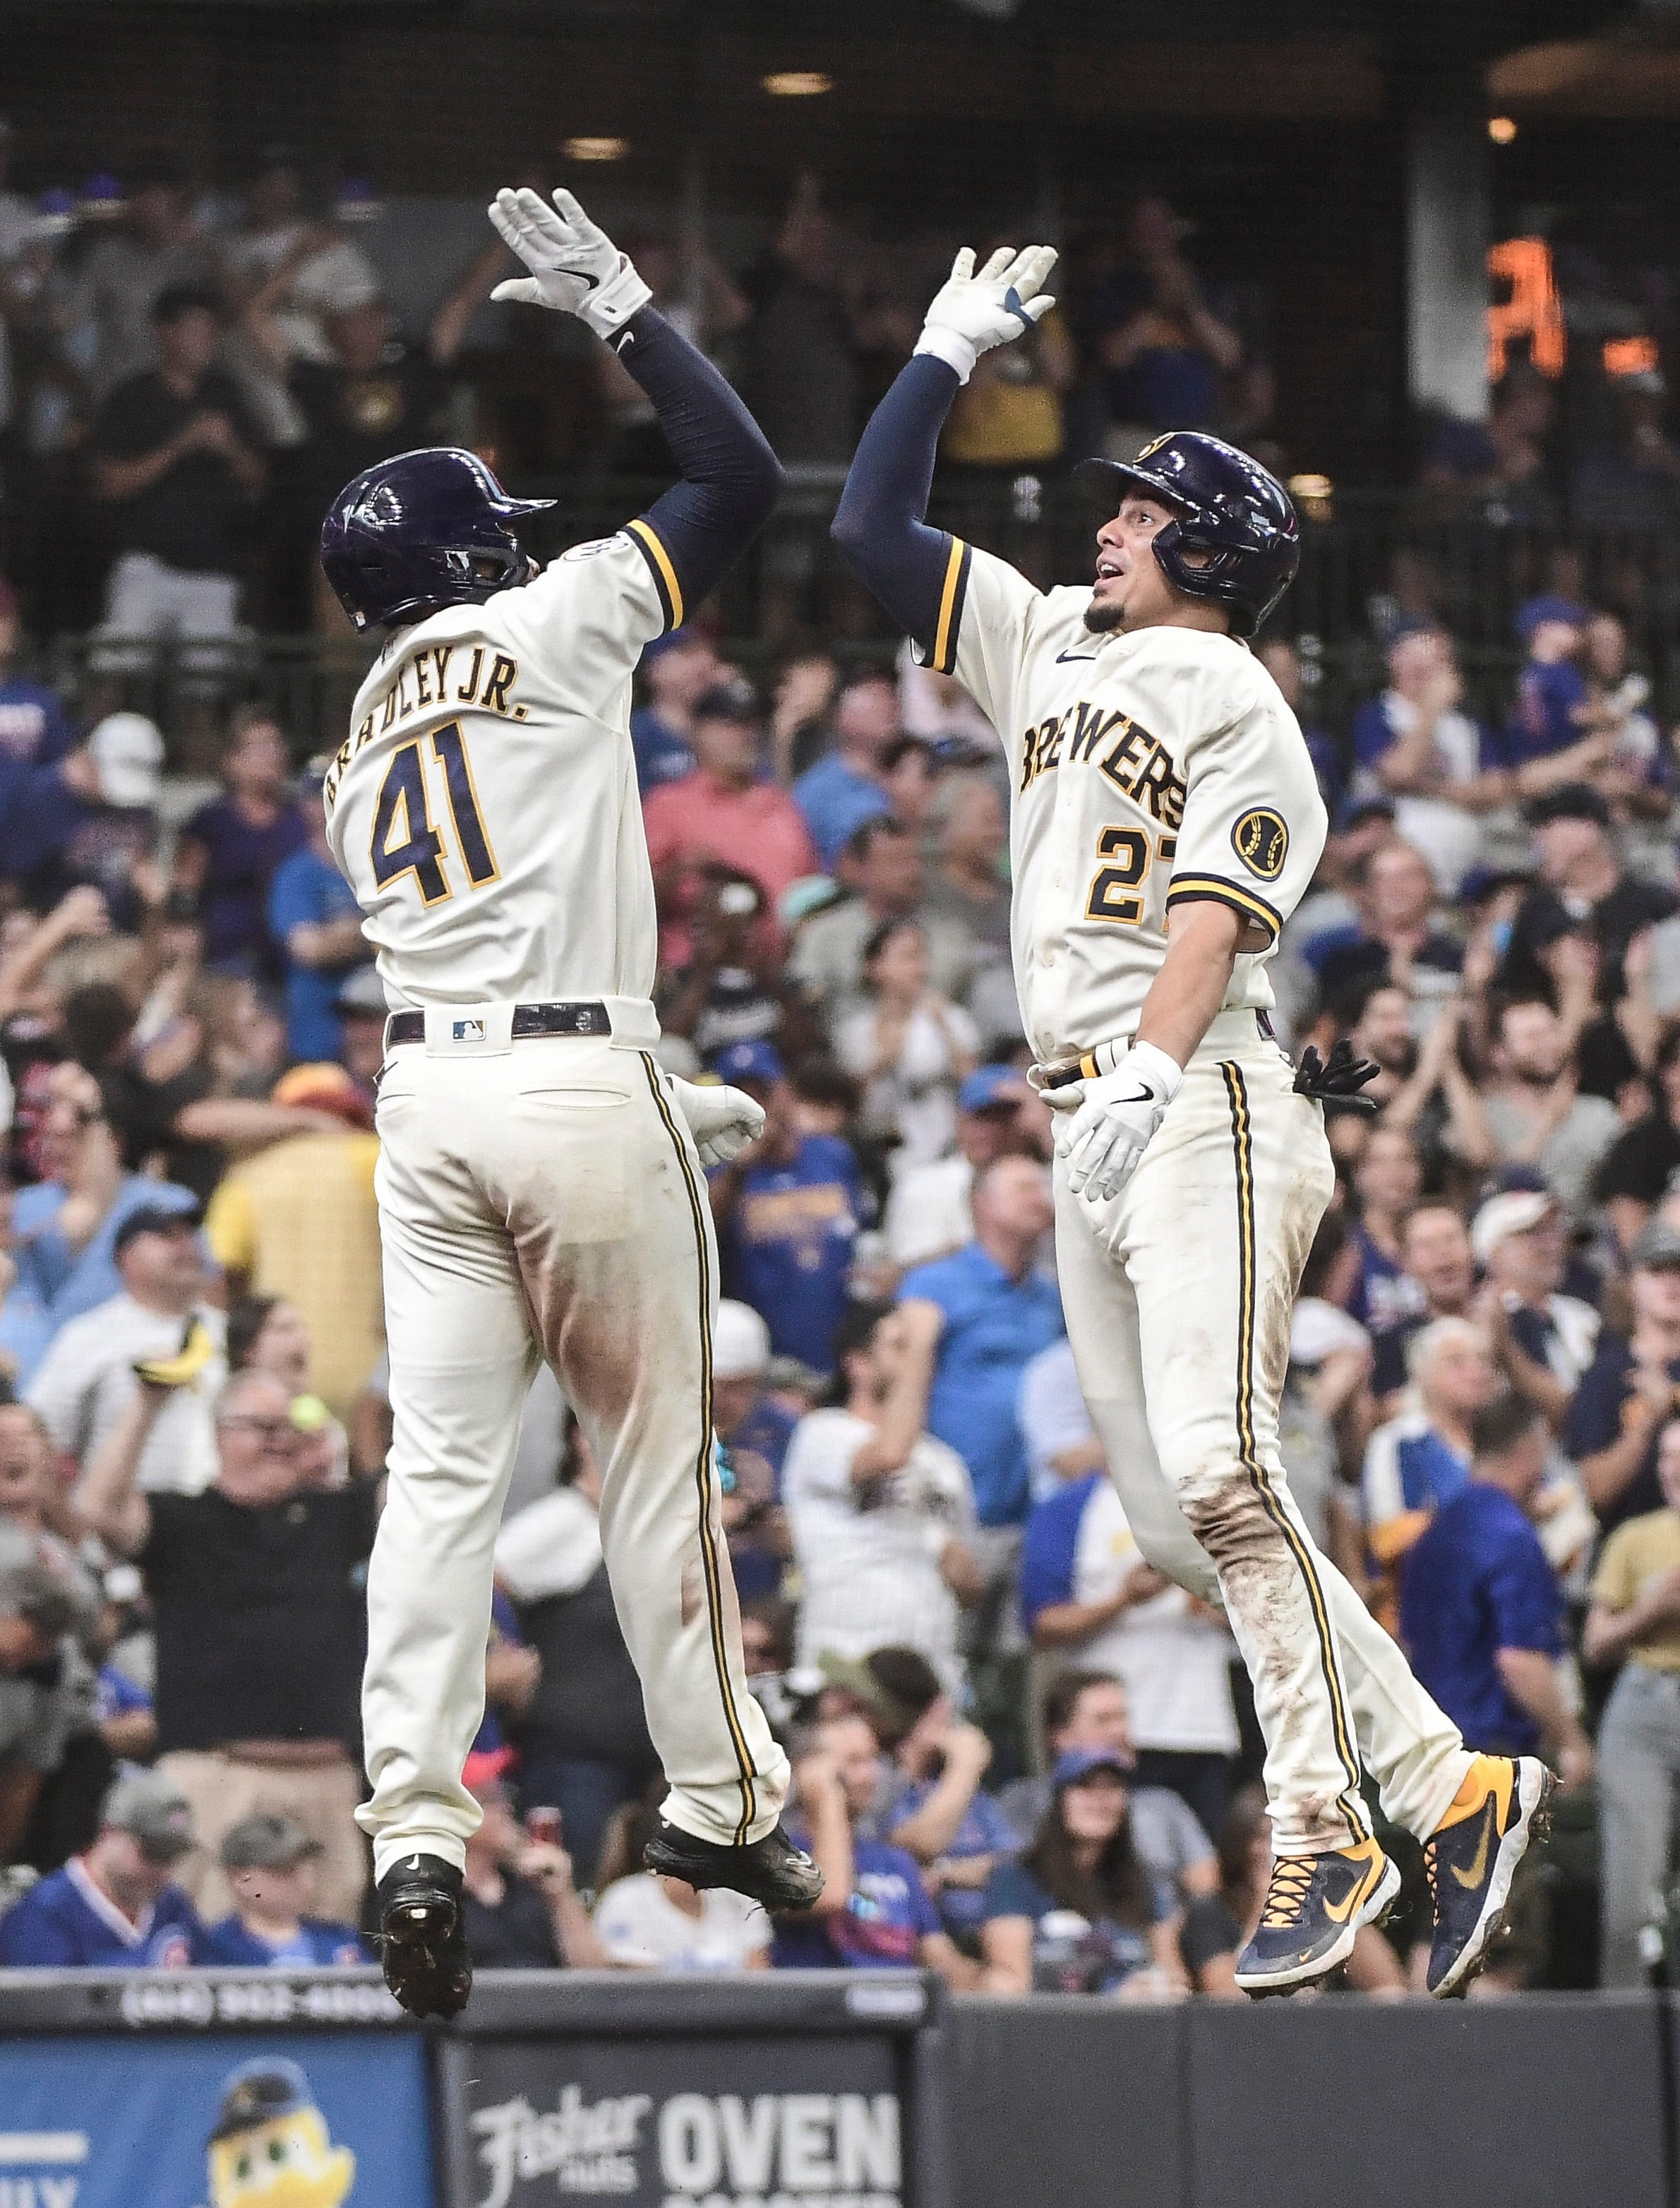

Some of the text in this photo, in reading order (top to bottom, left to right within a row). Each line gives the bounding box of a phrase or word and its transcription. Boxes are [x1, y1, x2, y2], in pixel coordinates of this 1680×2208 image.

[457, 644, 530, 722] JR.
[368, 717, 502, 909] 41
[1084, 825, 1178, 932] 2
[659, 2092, 904, 2190] OVEN
